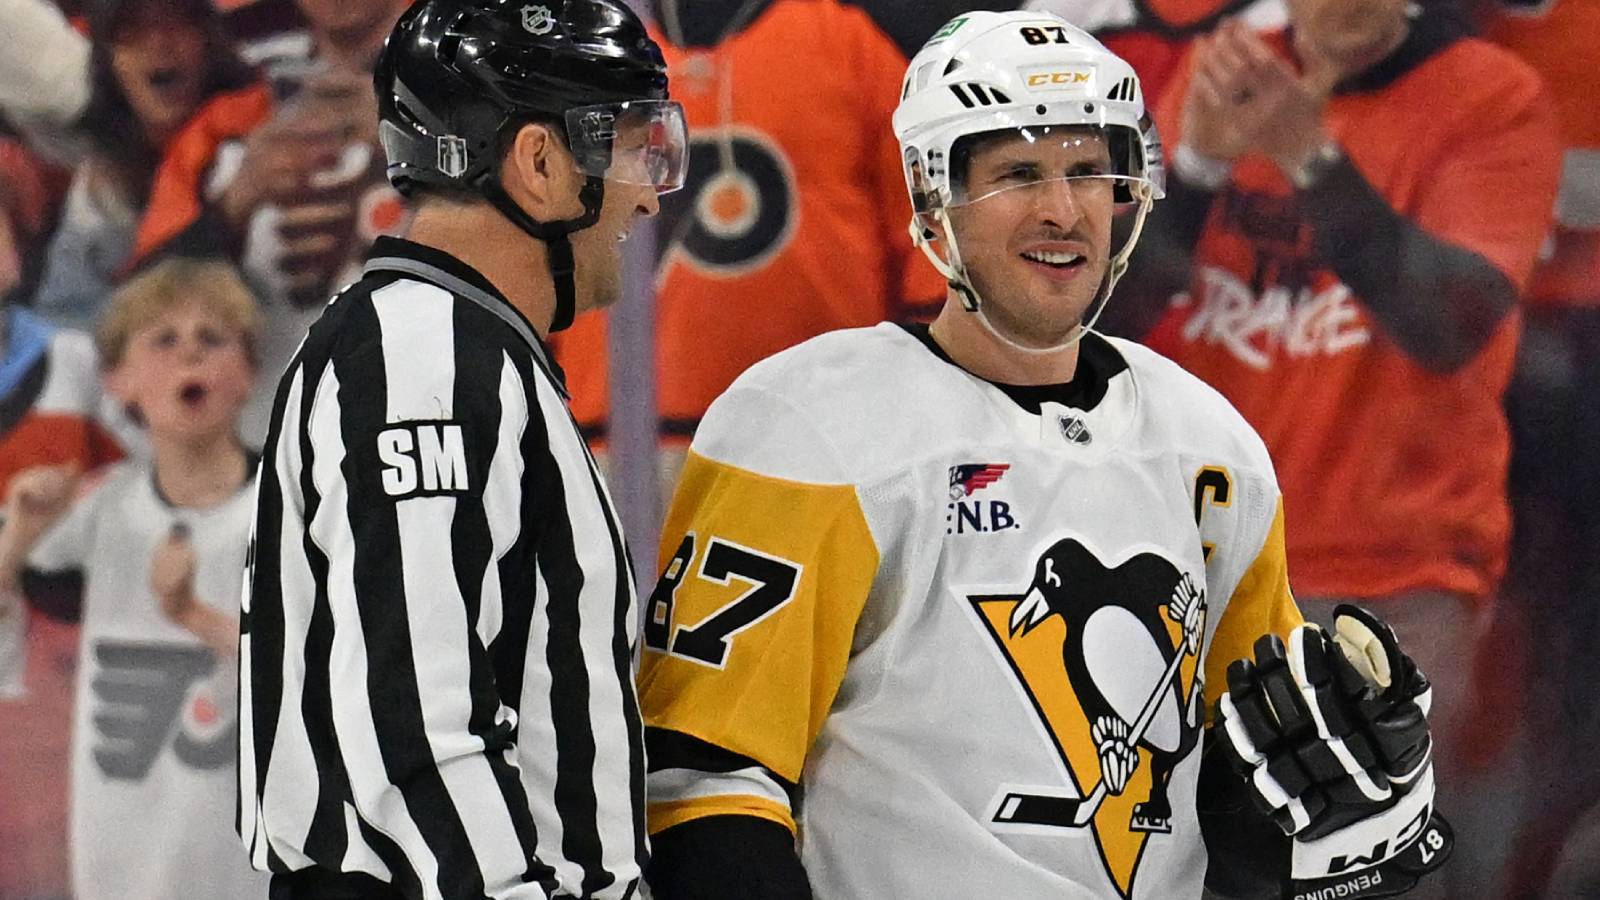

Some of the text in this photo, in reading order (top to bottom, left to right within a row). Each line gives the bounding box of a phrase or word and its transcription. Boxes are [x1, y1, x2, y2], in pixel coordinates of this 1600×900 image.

[1019, 26, 1070, 46] 87
[1028, 72, 1091, 87] CCM
[376, 424, 470, 497] SM
[946, 500, 1021, 534] .N.B.
[642, 530, 803, 671] 87
[1417, 828, 1445, 865] 87
